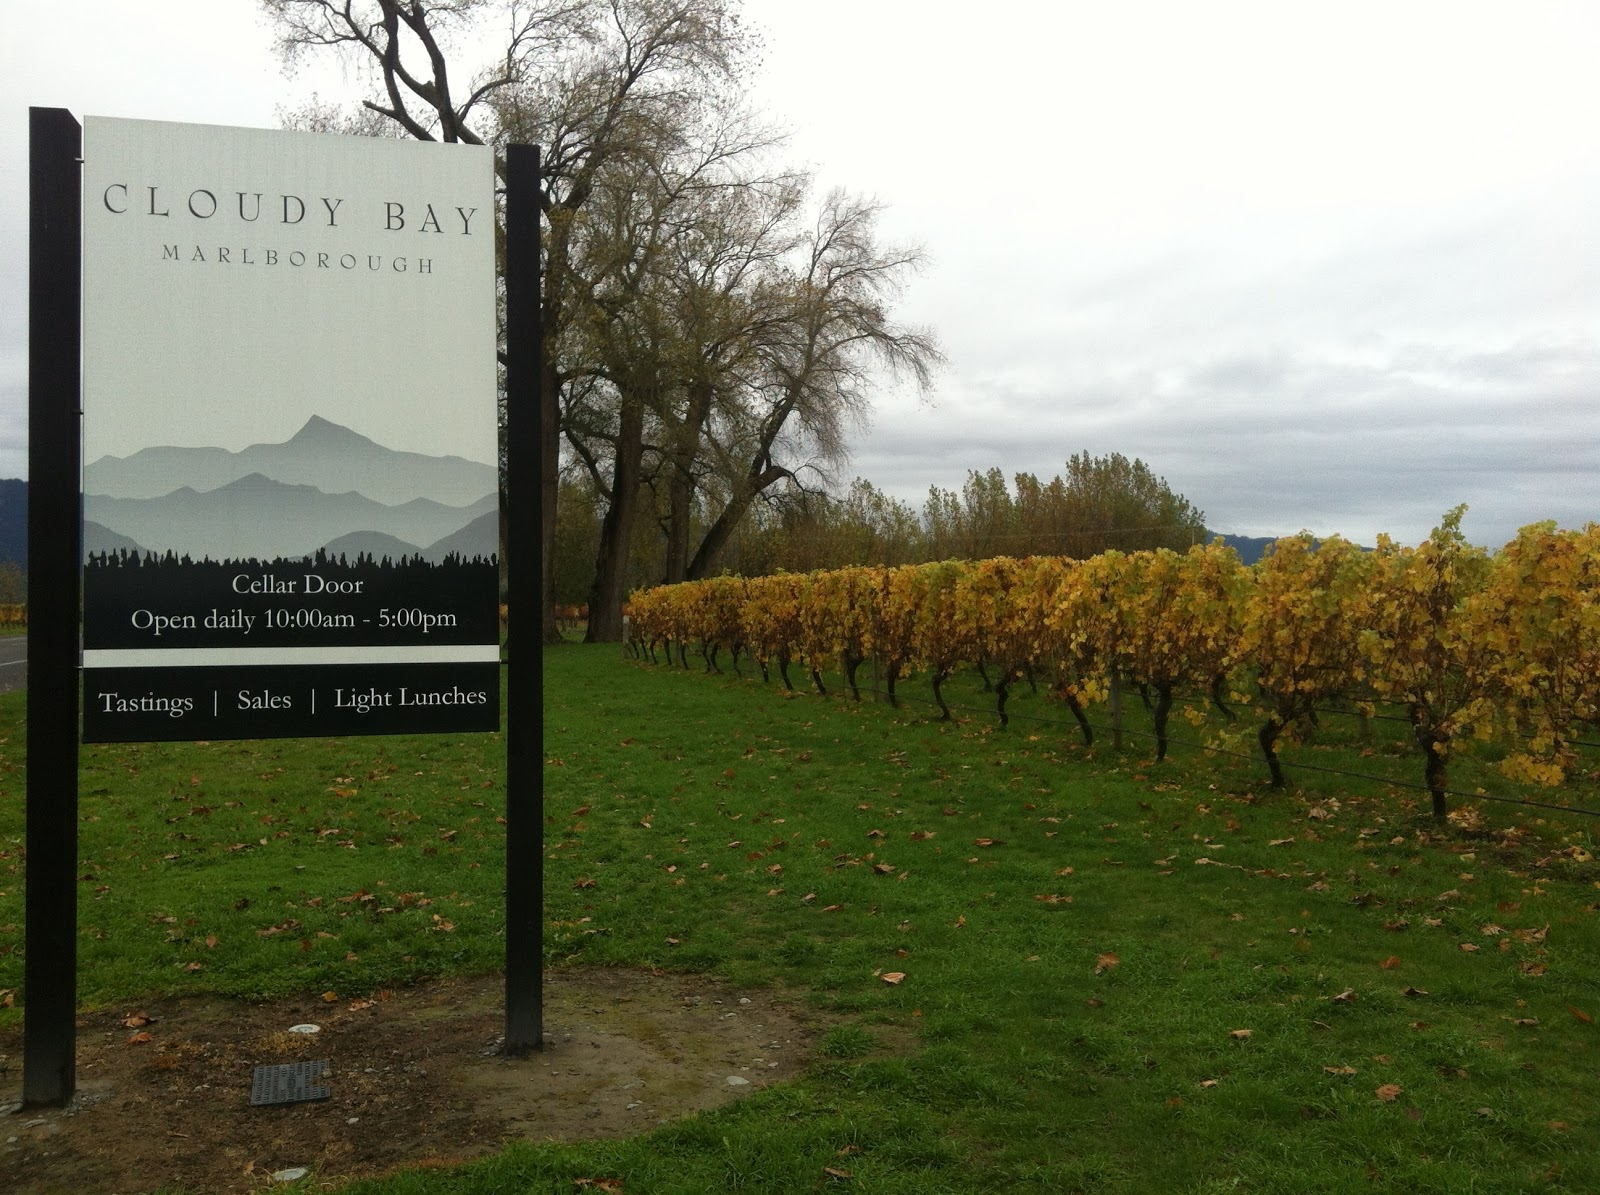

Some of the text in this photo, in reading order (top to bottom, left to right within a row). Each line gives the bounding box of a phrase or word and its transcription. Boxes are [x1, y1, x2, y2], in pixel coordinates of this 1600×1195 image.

[103, 183, 478, 236] CLOUDY BAY
[161, 244, 433, 274] MARLBOROUGH
[232, 574, 364, 595] Cellar Door
[131, 609, 197, 636] Open
[203, 608, 256, 635] daily
[264, 609, 356, 628] 10:00am
[378, 608, 457, 633] 5:00pm
[98, 686, 487, 718] Tastings Sales Light Lunches
